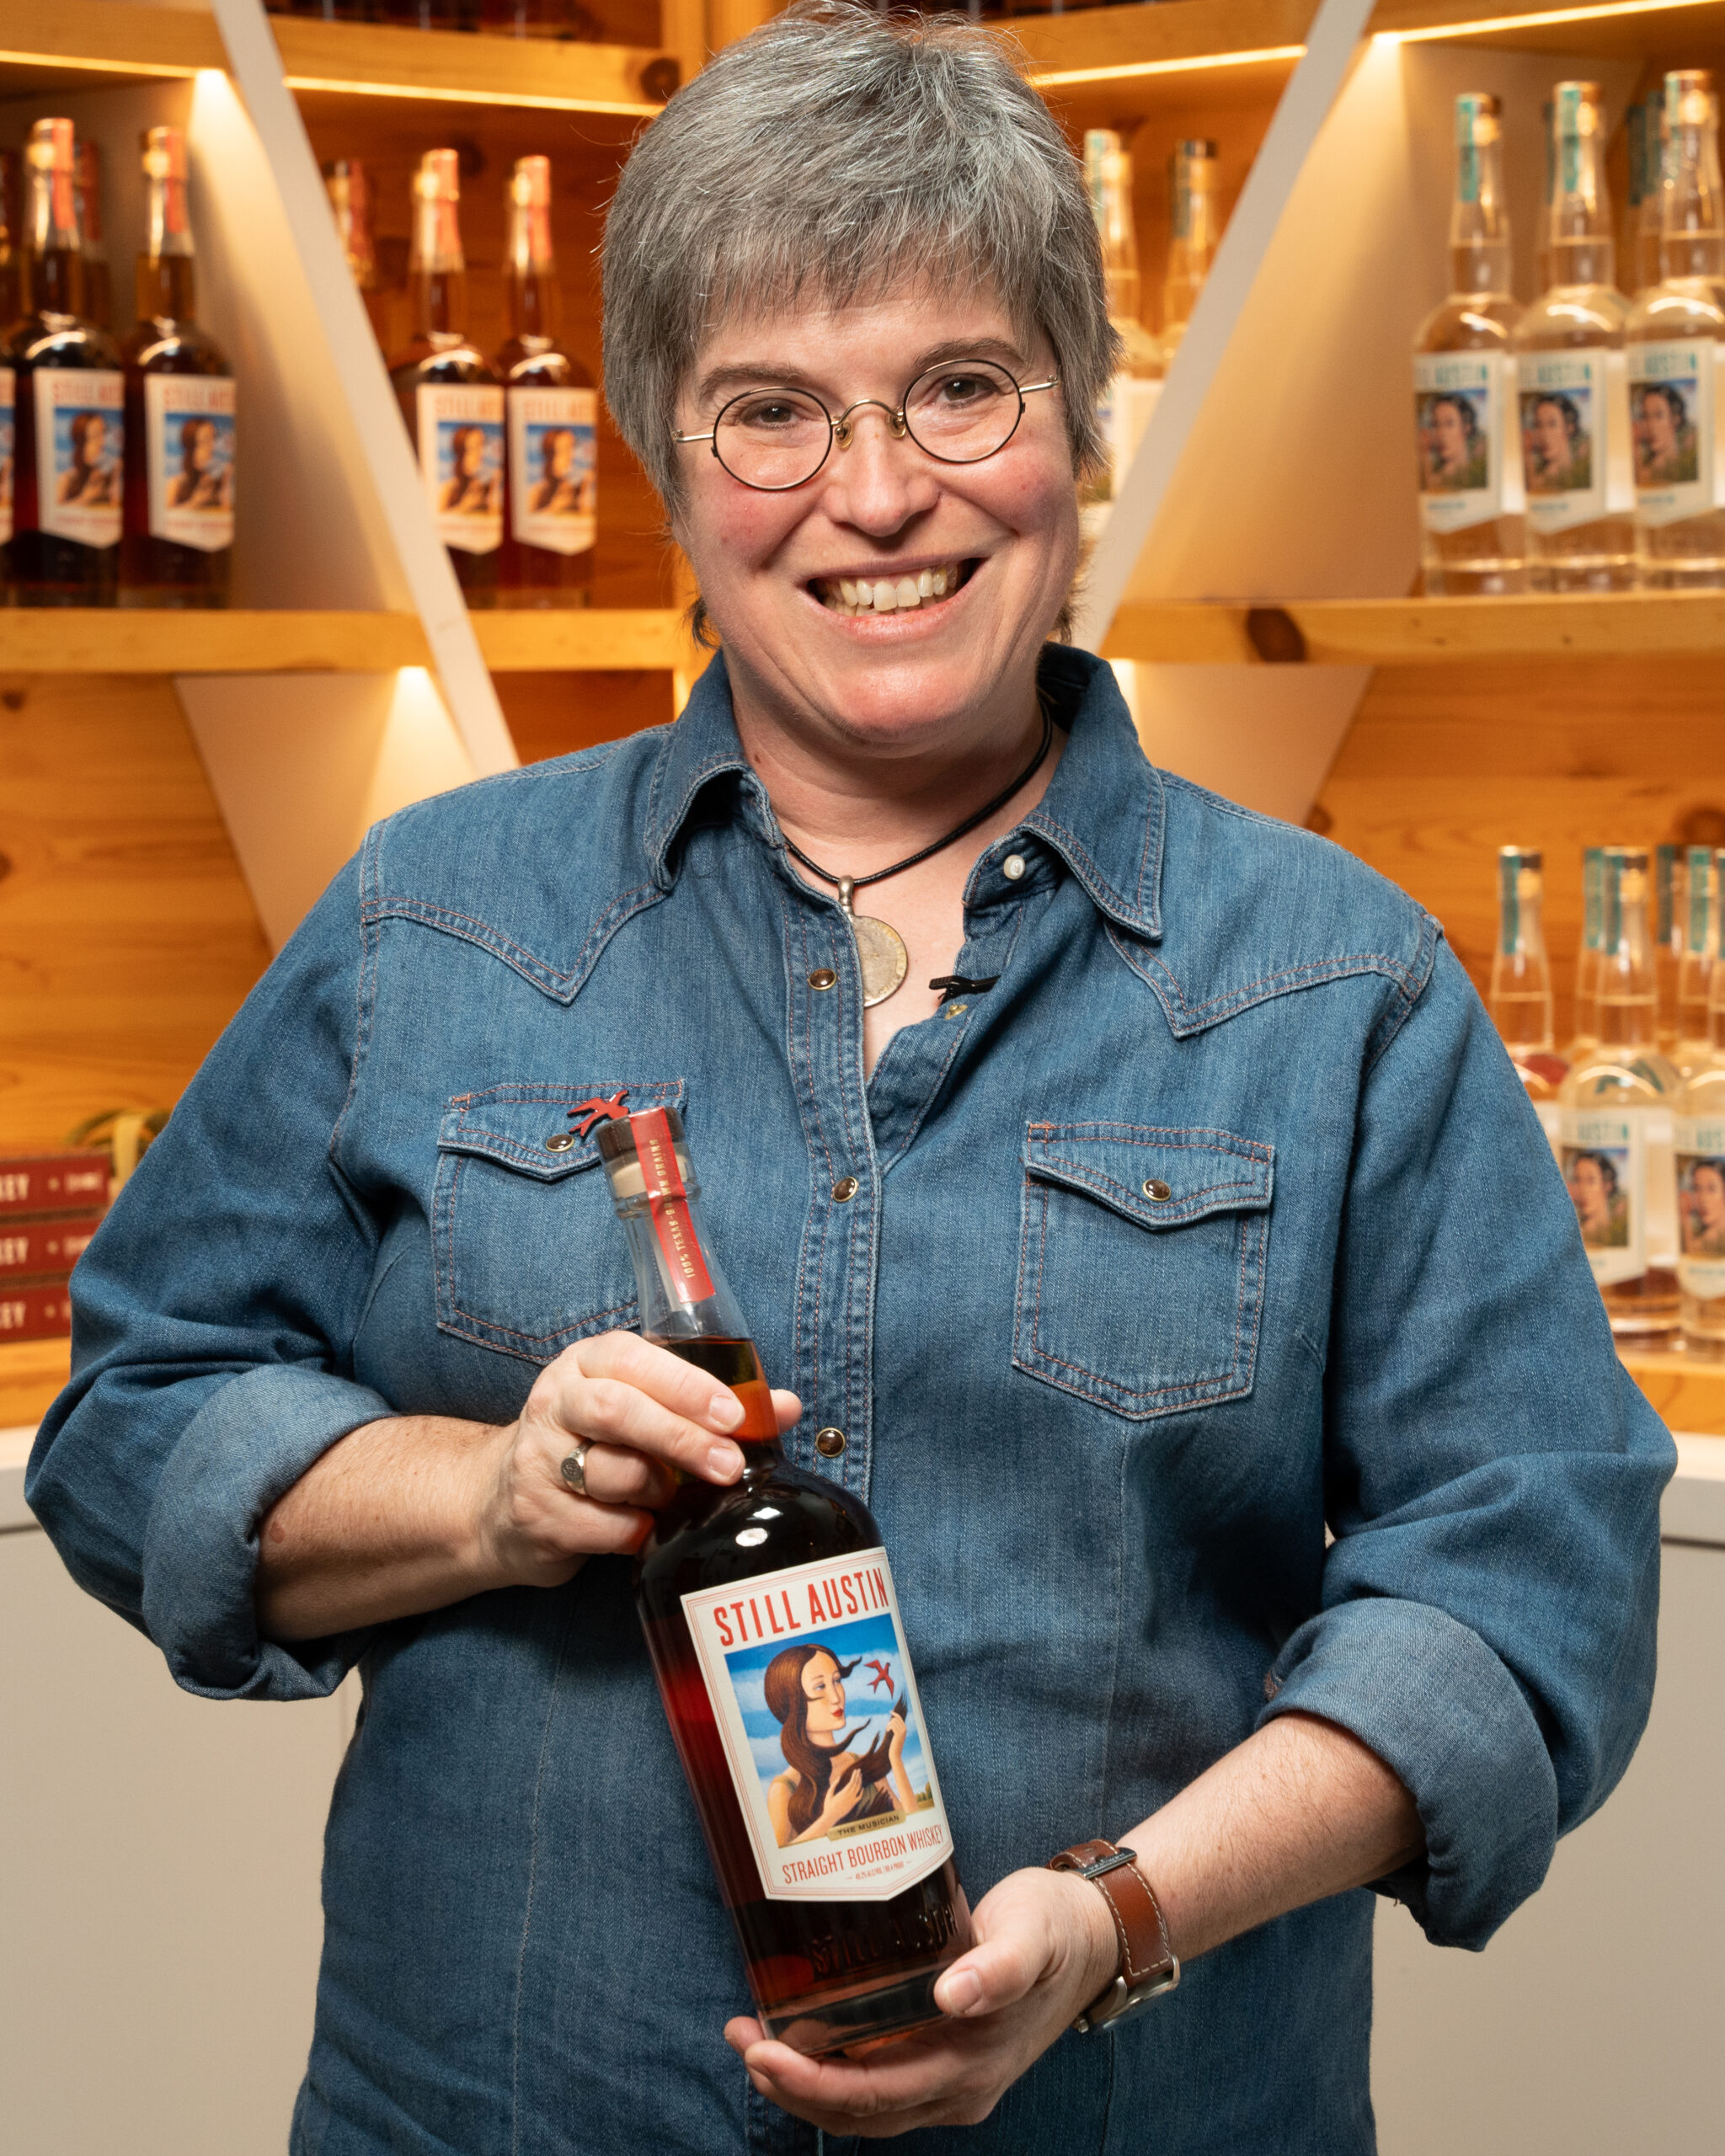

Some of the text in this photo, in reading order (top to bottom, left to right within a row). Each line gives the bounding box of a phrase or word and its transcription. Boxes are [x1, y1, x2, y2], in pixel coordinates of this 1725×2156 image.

[649, 1139, 666, 1177] GRAINS
[680, 1253, 696, 1278] 100%
[713, 1567, 889, 1646] STILL AUSTIN
[837, 1815, 900, 1837] THE MUSICIAN
[782, 1824, 944, 1884] STRAIGHT BOURBON WHISKEY
